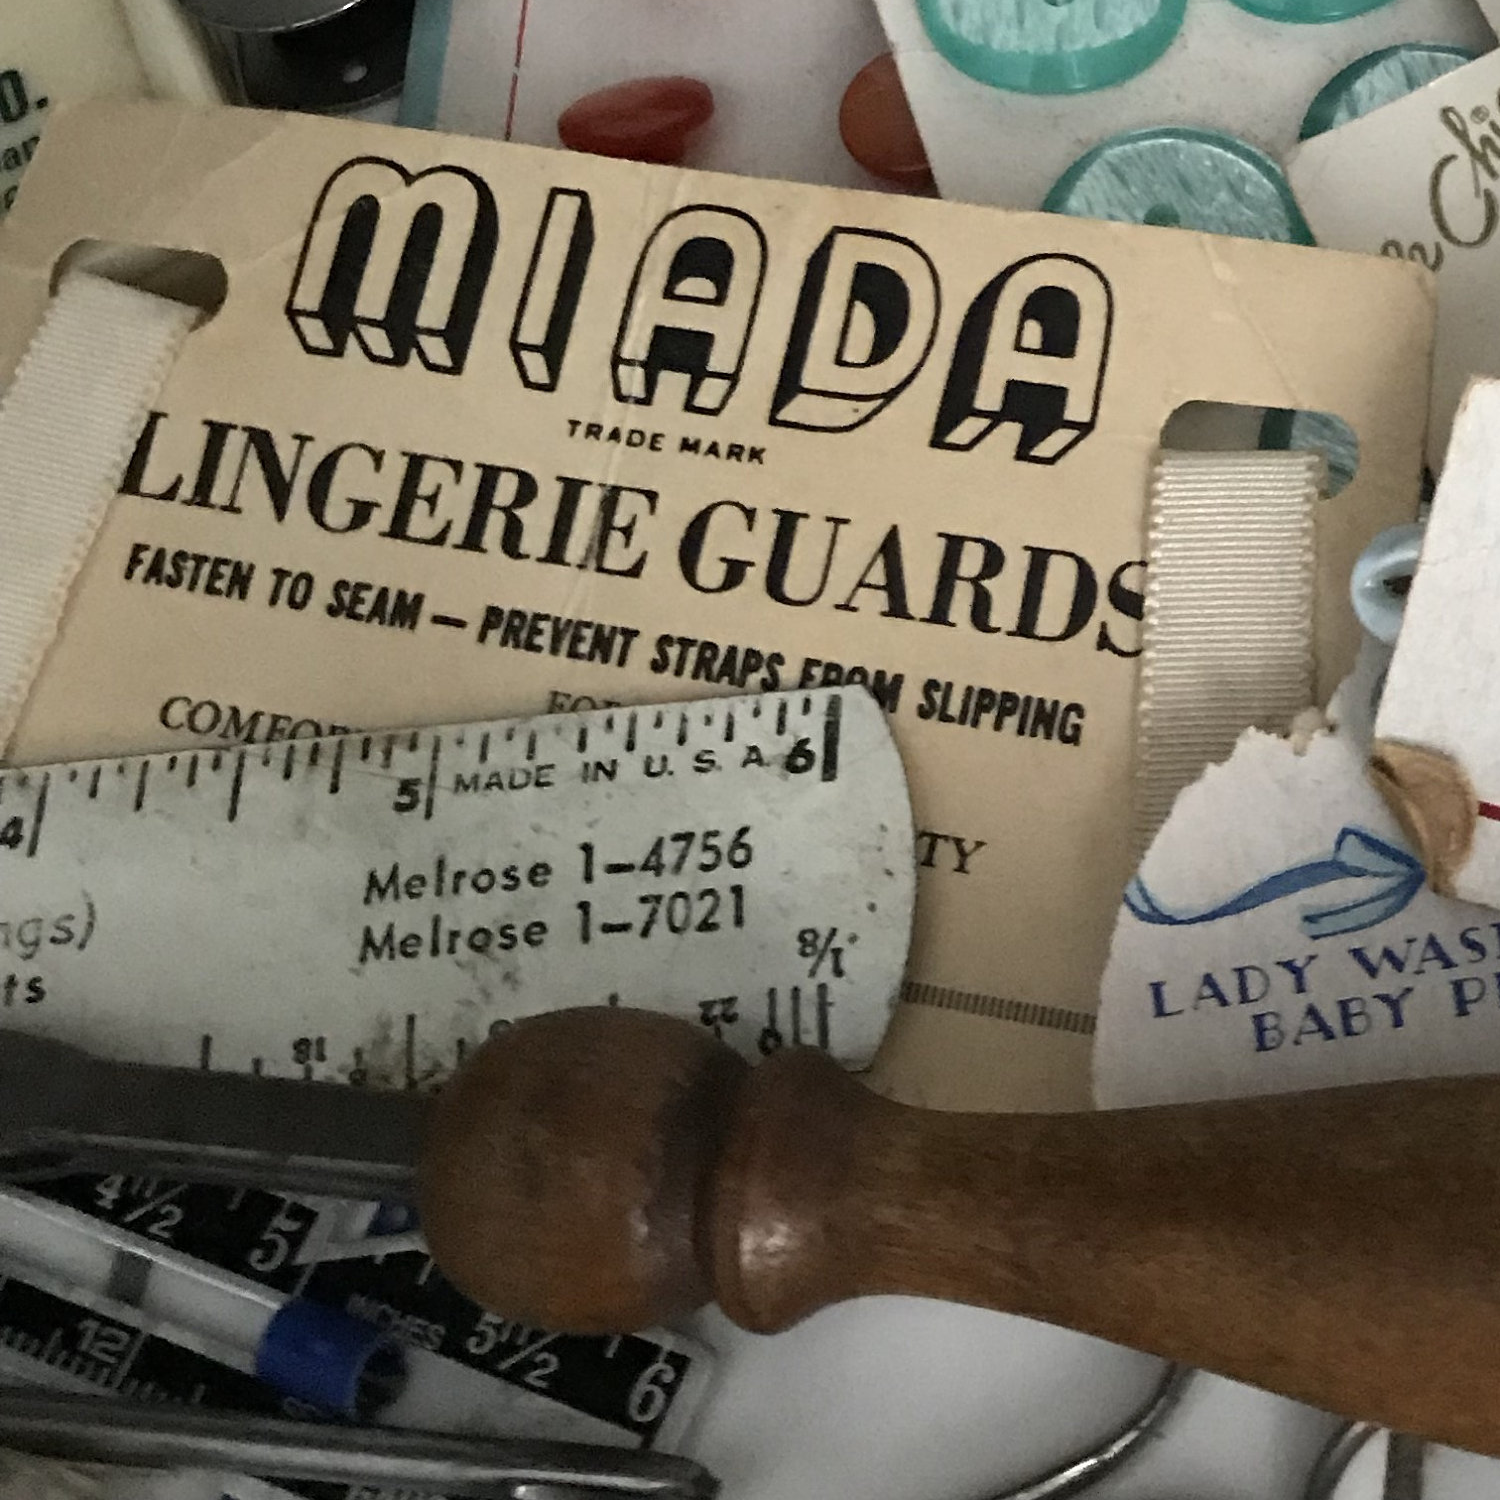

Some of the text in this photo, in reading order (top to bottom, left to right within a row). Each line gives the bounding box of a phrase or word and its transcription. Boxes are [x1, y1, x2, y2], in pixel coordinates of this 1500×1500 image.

[283, 154, 1115, 467] MIADA
[566, 418, 767, 466] TRADE MARK
[116, 409, 1150, 659] LINGERIE GUARDS
[123, 541, 256, 601] FASTEN
[267, 566, 314, 612] TO
[324, 578, 426, 633] SEAM
[476, 604, 640, 669] PREVENT
[649, 632, 786, 693] STRAPS
[915, 678, 1087, 747] SLIPPING
[453, 763, 557, 795] MADE
[580, 756, 619, 784] IN
[785, 736, 817, 775] 6
[391, 777, 422, 814] 5
[364, 852, 555, 905] Melrose
[357, 913, 549, 965] Melrose
[1147, 952, 1319, 1019] LADY
[1249, 985, 1415, 1053] BABY
